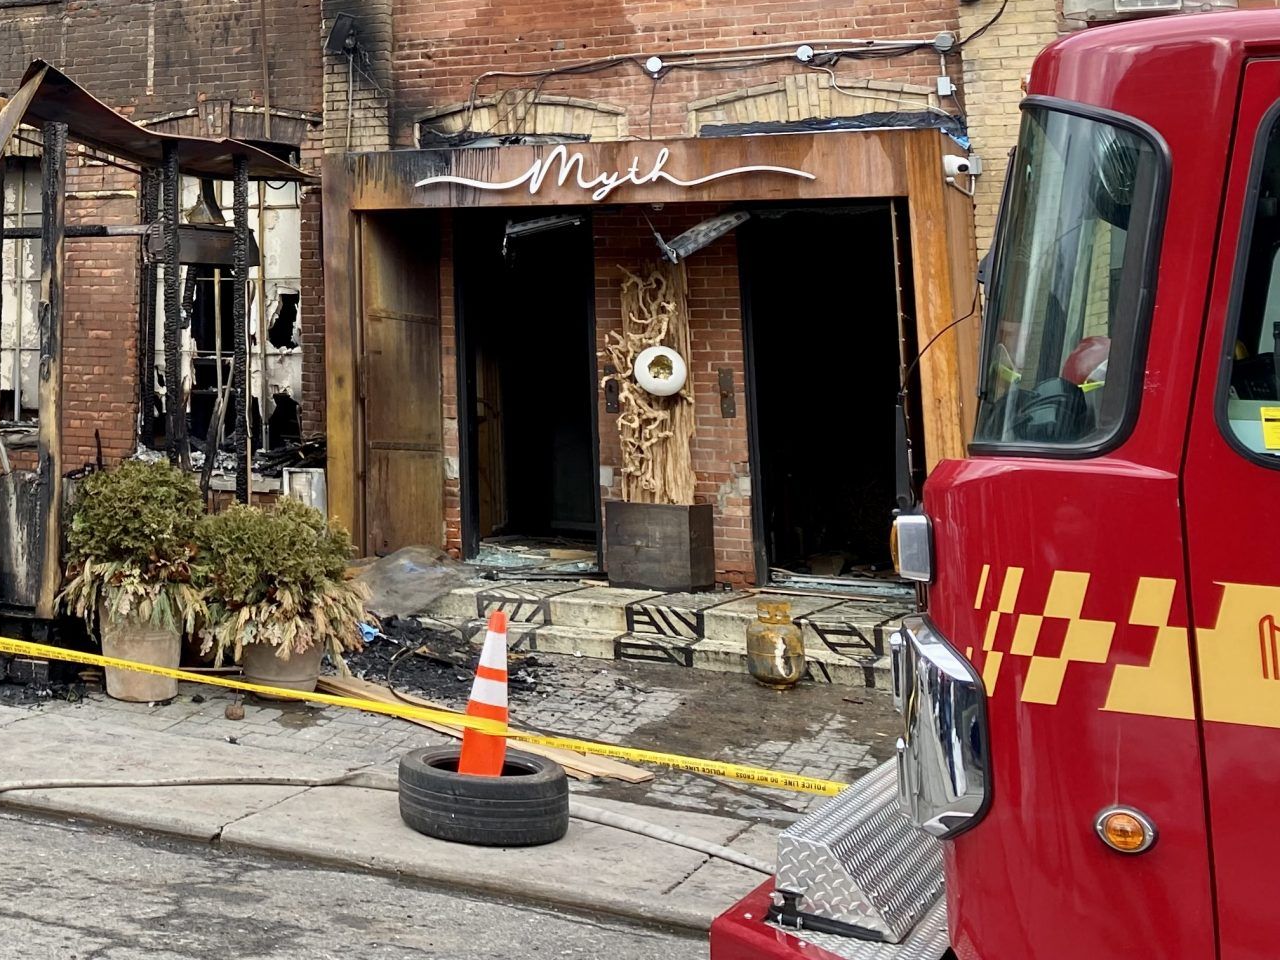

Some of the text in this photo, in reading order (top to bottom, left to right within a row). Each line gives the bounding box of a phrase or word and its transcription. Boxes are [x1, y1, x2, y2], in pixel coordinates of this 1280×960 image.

[734, 771, 755, 780] CROSS
[756, 774, 769, 782] NOT
[800, 781, 827, 792] POLICE
